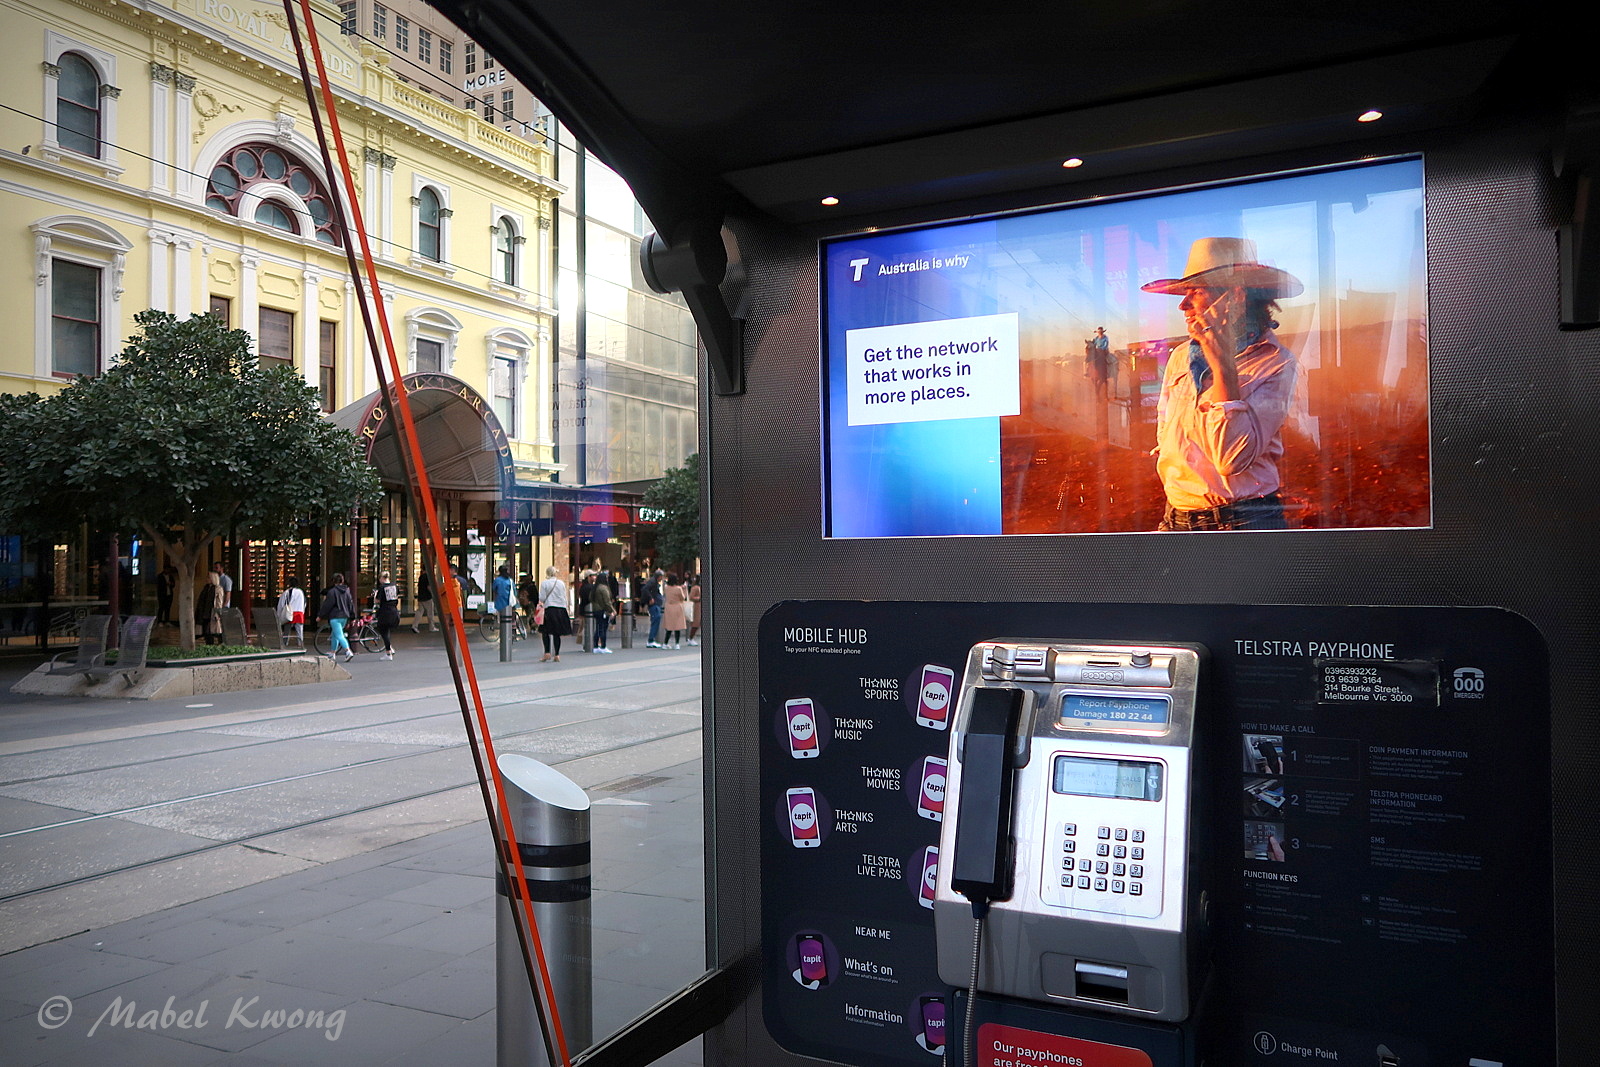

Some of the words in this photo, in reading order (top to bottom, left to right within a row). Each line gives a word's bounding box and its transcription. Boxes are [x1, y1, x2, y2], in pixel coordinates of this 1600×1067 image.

[205, 0, 273, 42] ROYAL
[281, 31, 354, 79] ACADE
[464, 69, 506, 91] MORE
[850, 257, 869, 282] T
[878, 259, 930, 276] Australia
[932, 257, 942, 269] is
[945, 254, 969, 268] why
[864, 348, 892, 363] Get
[896, 345, 923, 360] the
[928, 336, 998, 358] network
[864, 368, 897, 384] that
[902, 363, 951, 381] works
[956, 361, 971, 376] in
[865, 390, 906, 405] more
[911, 385, 970, 405] places.
[363, 377, 423, 439] ROL
[459, 387, 513, 474] ARCADE
[784, 627, 834, 643] MOBILE
[838, 628, 868, 644] HUB
[1234, 640, 1303, 657] TELSTRA
[1308, 641, 1395, 659] PAYPHONE
[1324, 667, 1377, 676] 03963932X2
[1362, 676, 1382, 684] 3164
[1453, 678, 1484, 692] 000
[864, 689, 899, 701] SPORTS
[1341, 684, 1371, 693] Bourke
[1374, 685, 1403, 694] Street,
[925, 690, 945, 702] tapit
[1324, 692, 1369, 701] Melbourne
[1373, 693, 1387, 702] Vic
[1390, 694, 1413, 702] 3000
[1079, 699, 1107, 708] Report
[1108, 700, 1150, 710] Payphone
[1073, 710, 1107, 719] Damage
[1110, 711, 1126, 719] 180
[1128, 712, 1139, 720] 22
[1141, 712, 1152, 720] 44
[793, 723, 810, 732] tapit
[1270, 724, 1289, 732] MAKE
[1298, 725, 1316, 734] CALL
[834, 730, 862, 741] MUSIC
[1291, 750, 1297, 761] 1
[1369, 746, 1385, 754] COIN
[1387, 747, 1419, 756] PAYMENT
[1421, 749, 1469, 759] INFORMATION
[866, 778, 900, 791] MOVIES
[1290, 794, 1299, 806] 2
[1369, 790, 1399, 799] TELSTRA
[1400, 791, 1443, 802] PHONECARD
[1370, 798, 1416, 808] INFORMATION
[794, 812, 812, 821] tapit
[835, 822, 858, 834] ARTS
[1291, 838, 1300, 849] 3
[1370, 836, 1385, 844] SMS
[862, 853, 900, 868] TELSTRA
[857, 865, 876, 877] LIVE
[878, 868, 902, 880] PASS
[1243, 869, 1278, 880] FUNCTION
[1280, 873, 1298, 883] KEYS
[855, 926, 876, 938] NEAR
[879, 928, 891, 940] ME
[803, 954, 822, 965] tapit
[844, 957, 878, 973] What's
[880, 966, 893, 976] on
[845, 1002, 903, 1025] Information
[993, 1040, 1014, 1054] Our
[1017, 1045, 1083, 1067] payphones
[1281, 1042, 1312, 1058] Charge
[1315, 1047, 1338, 1060] Point
